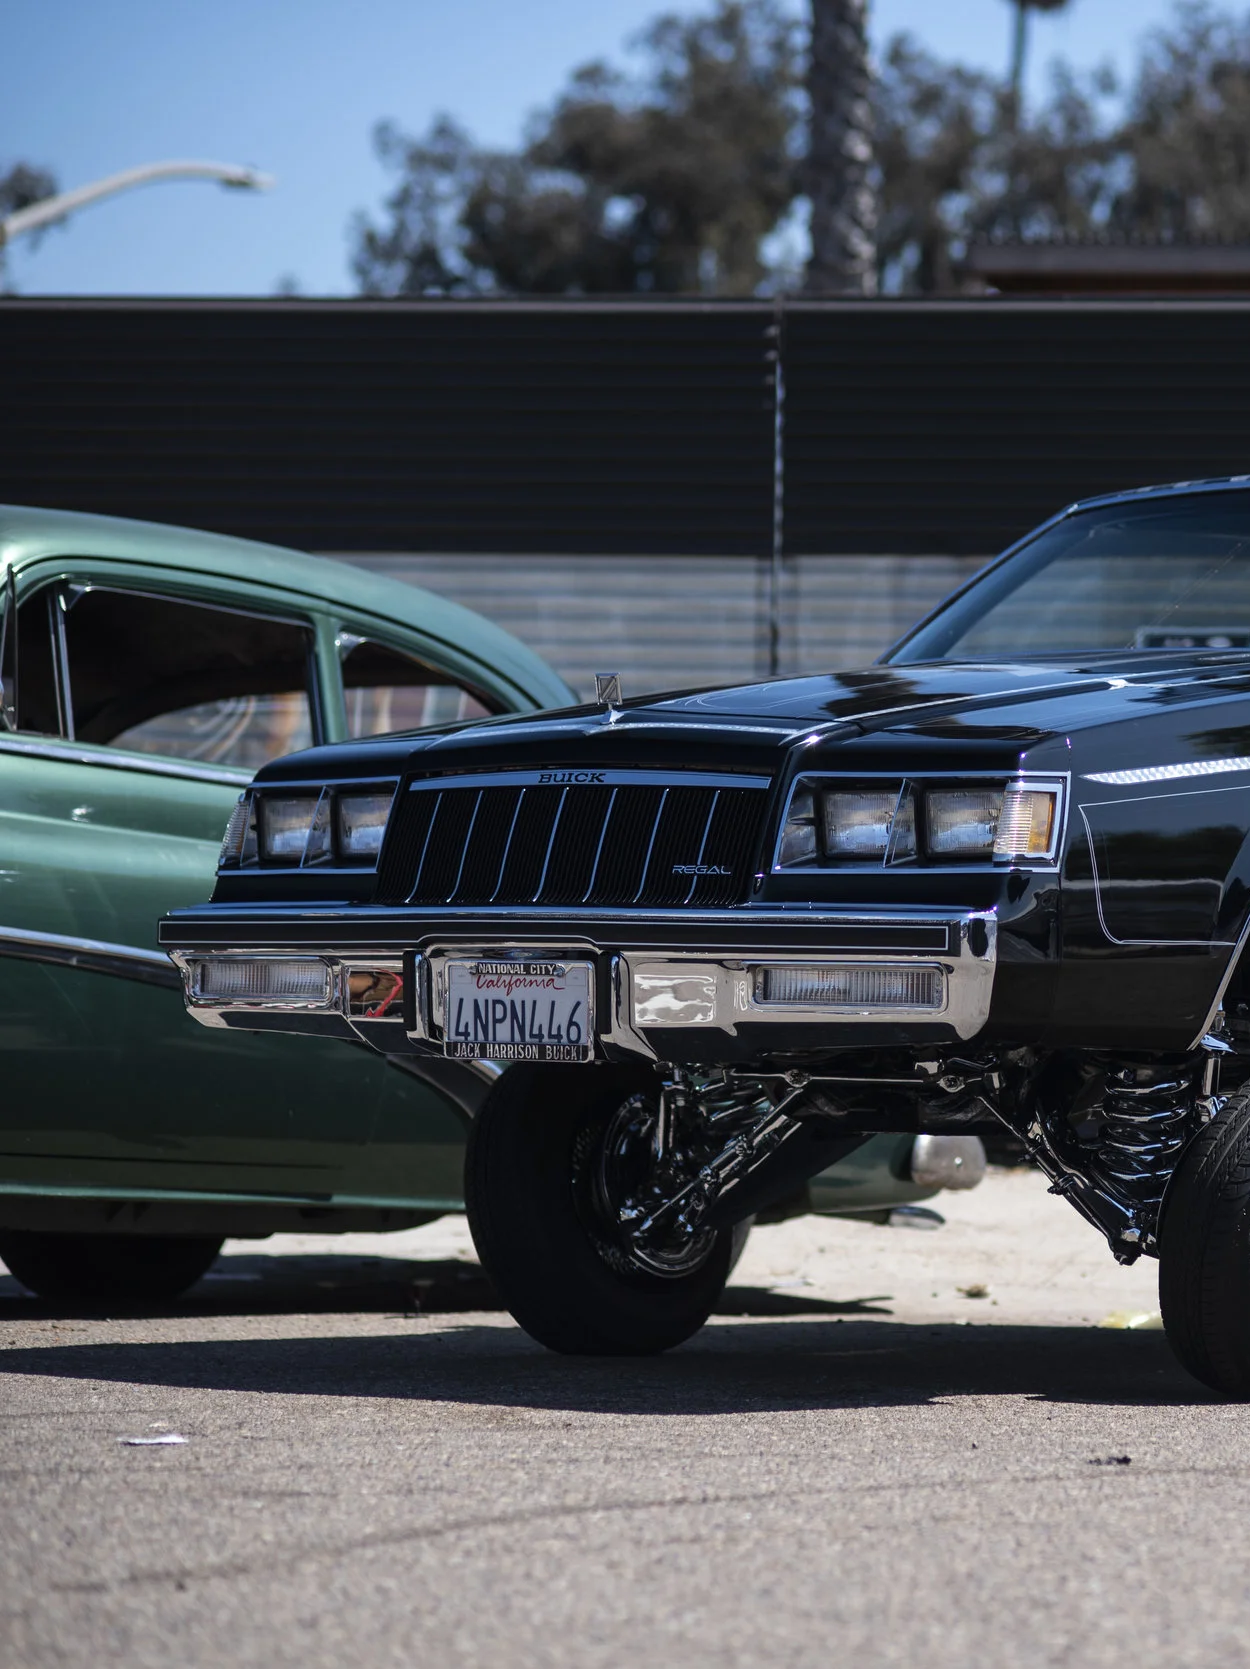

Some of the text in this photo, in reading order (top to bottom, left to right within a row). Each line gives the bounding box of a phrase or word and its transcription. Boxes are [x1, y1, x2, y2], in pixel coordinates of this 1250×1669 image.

[538, 772, 607, 784] BUICK
[672, 865, 731, 875] REGAL
[478, 963, 556, 975] NATIONAL CITY
[476, 975, 565, 996] California
[454, 997, 582, 1044] 4NPN446
[454, 1042, 578, 1061] JACK HARRISON BUICK
